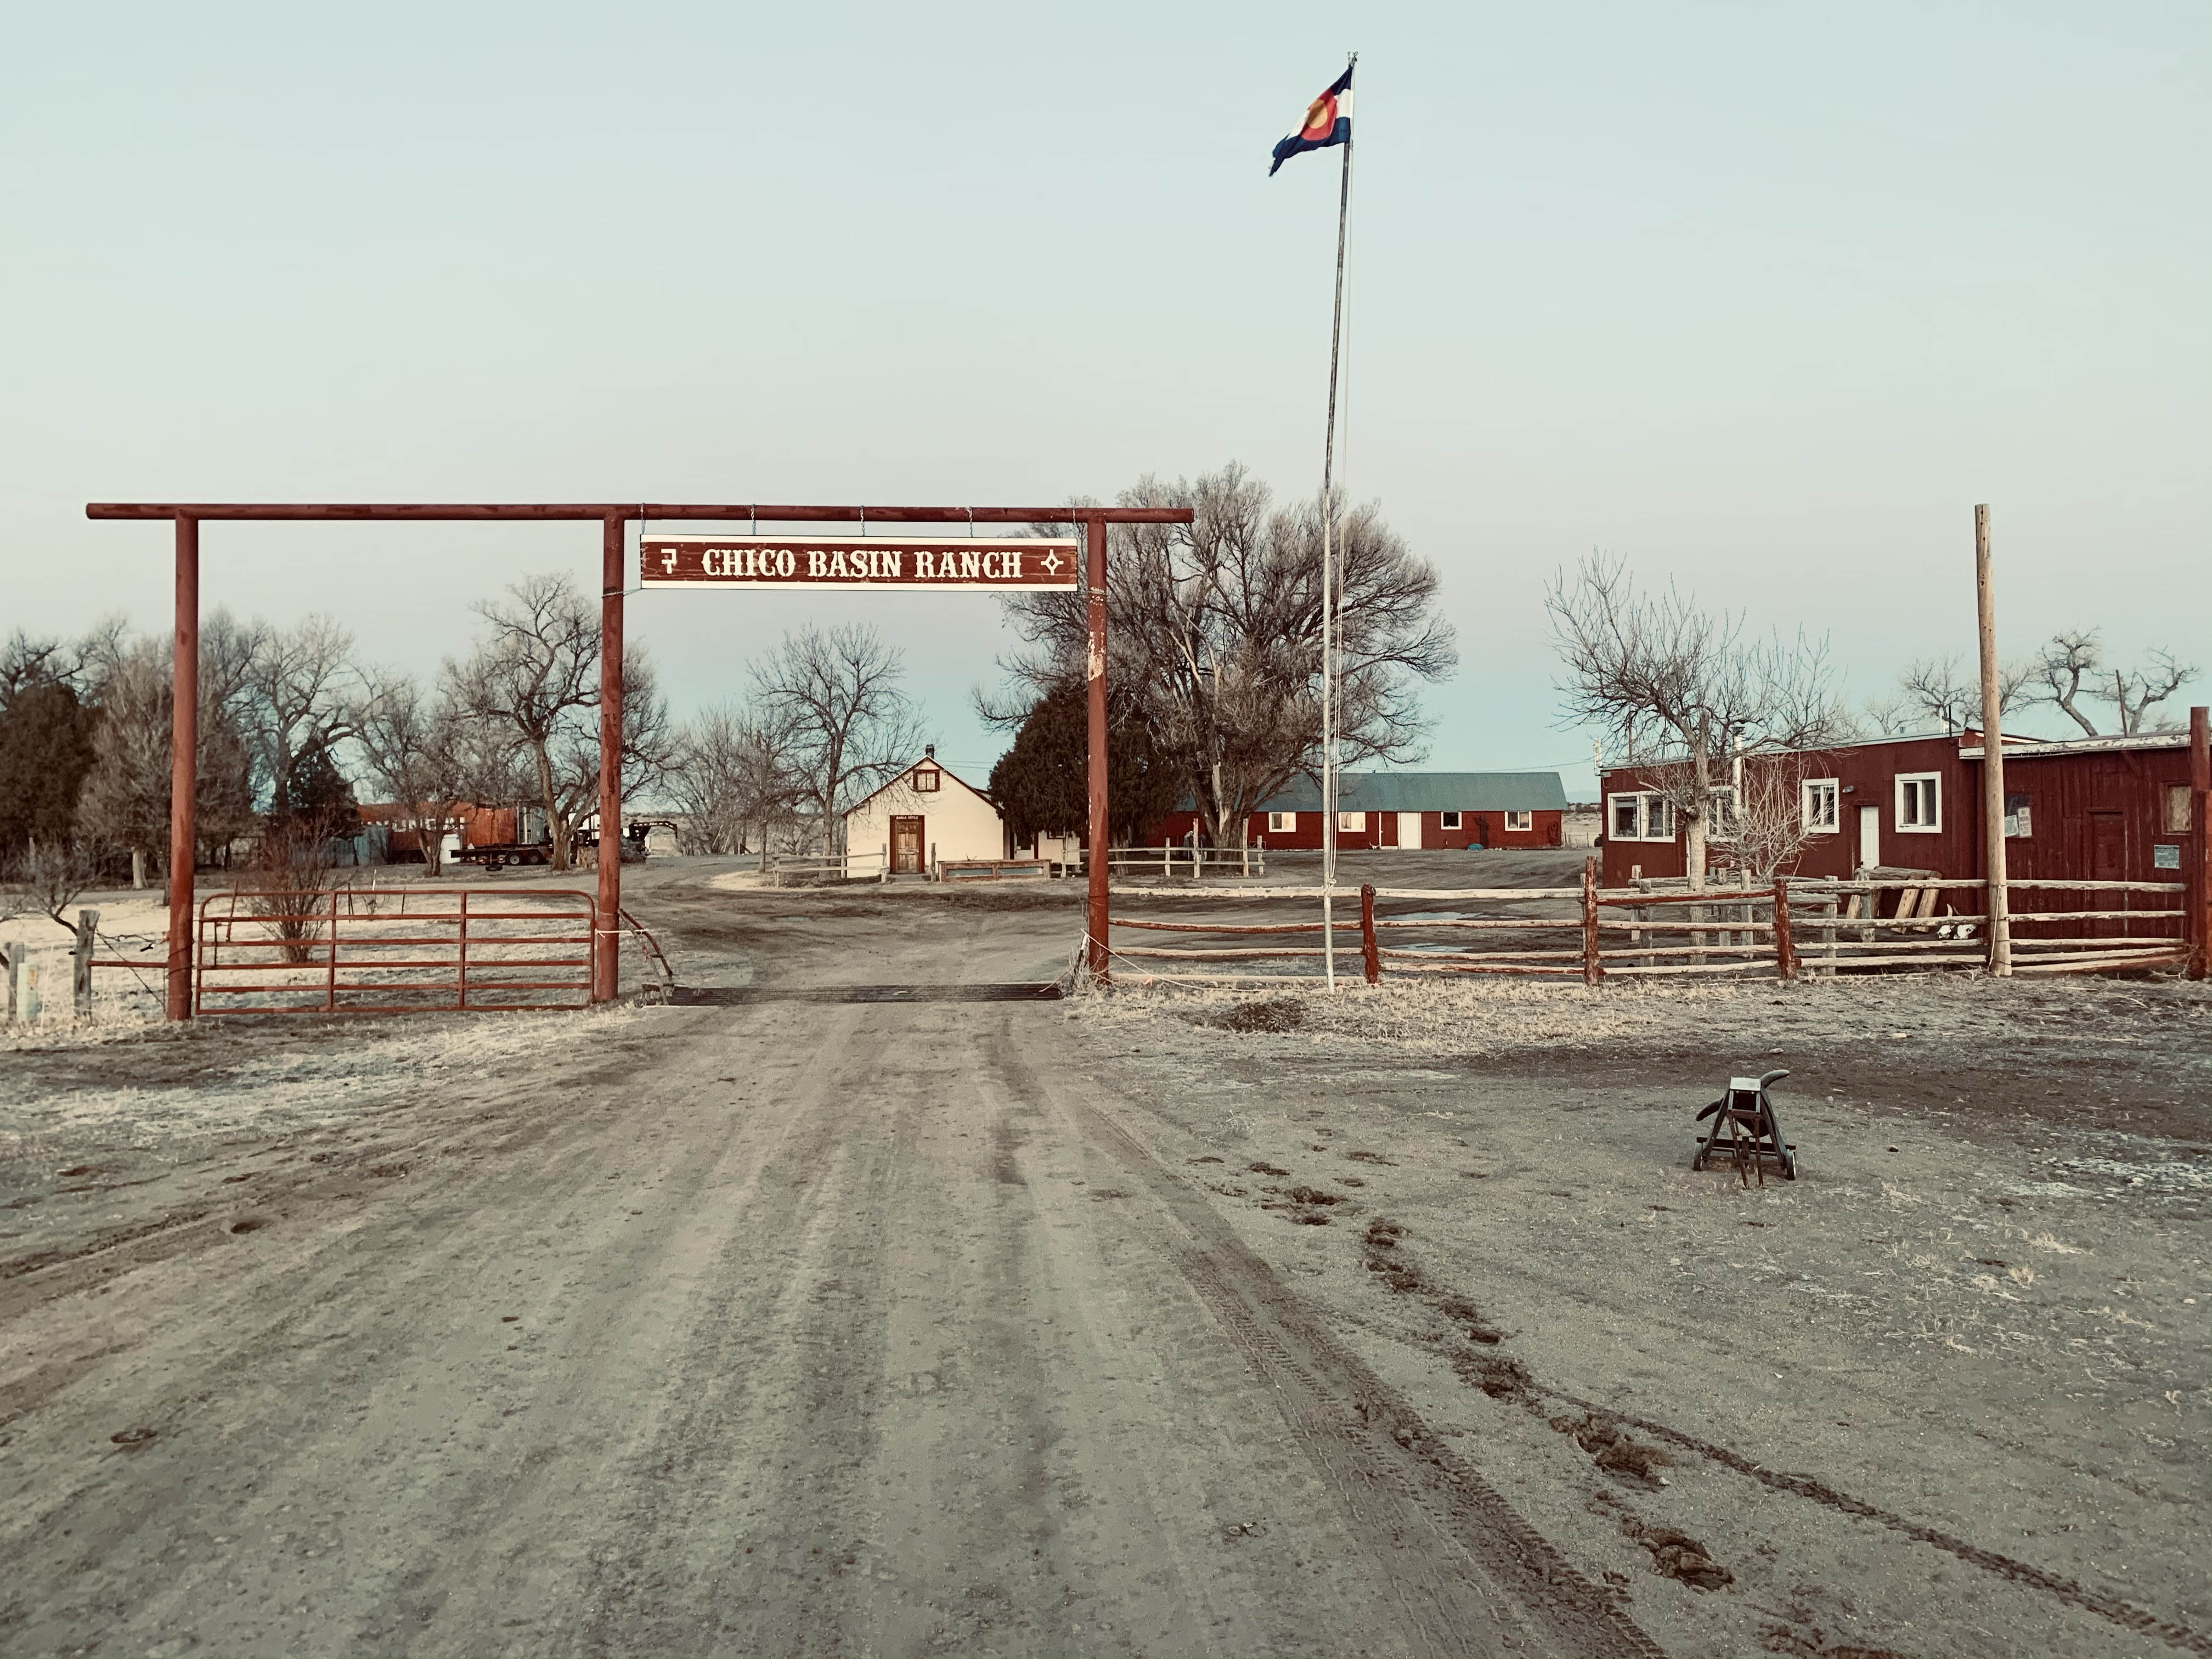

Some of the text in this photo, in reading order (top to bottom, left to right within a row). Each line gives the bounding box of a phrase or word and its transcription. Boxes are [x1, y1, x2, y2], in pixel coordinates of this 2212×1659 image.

[701, 549, 1023, 579] CHICO BASIN RANCH
